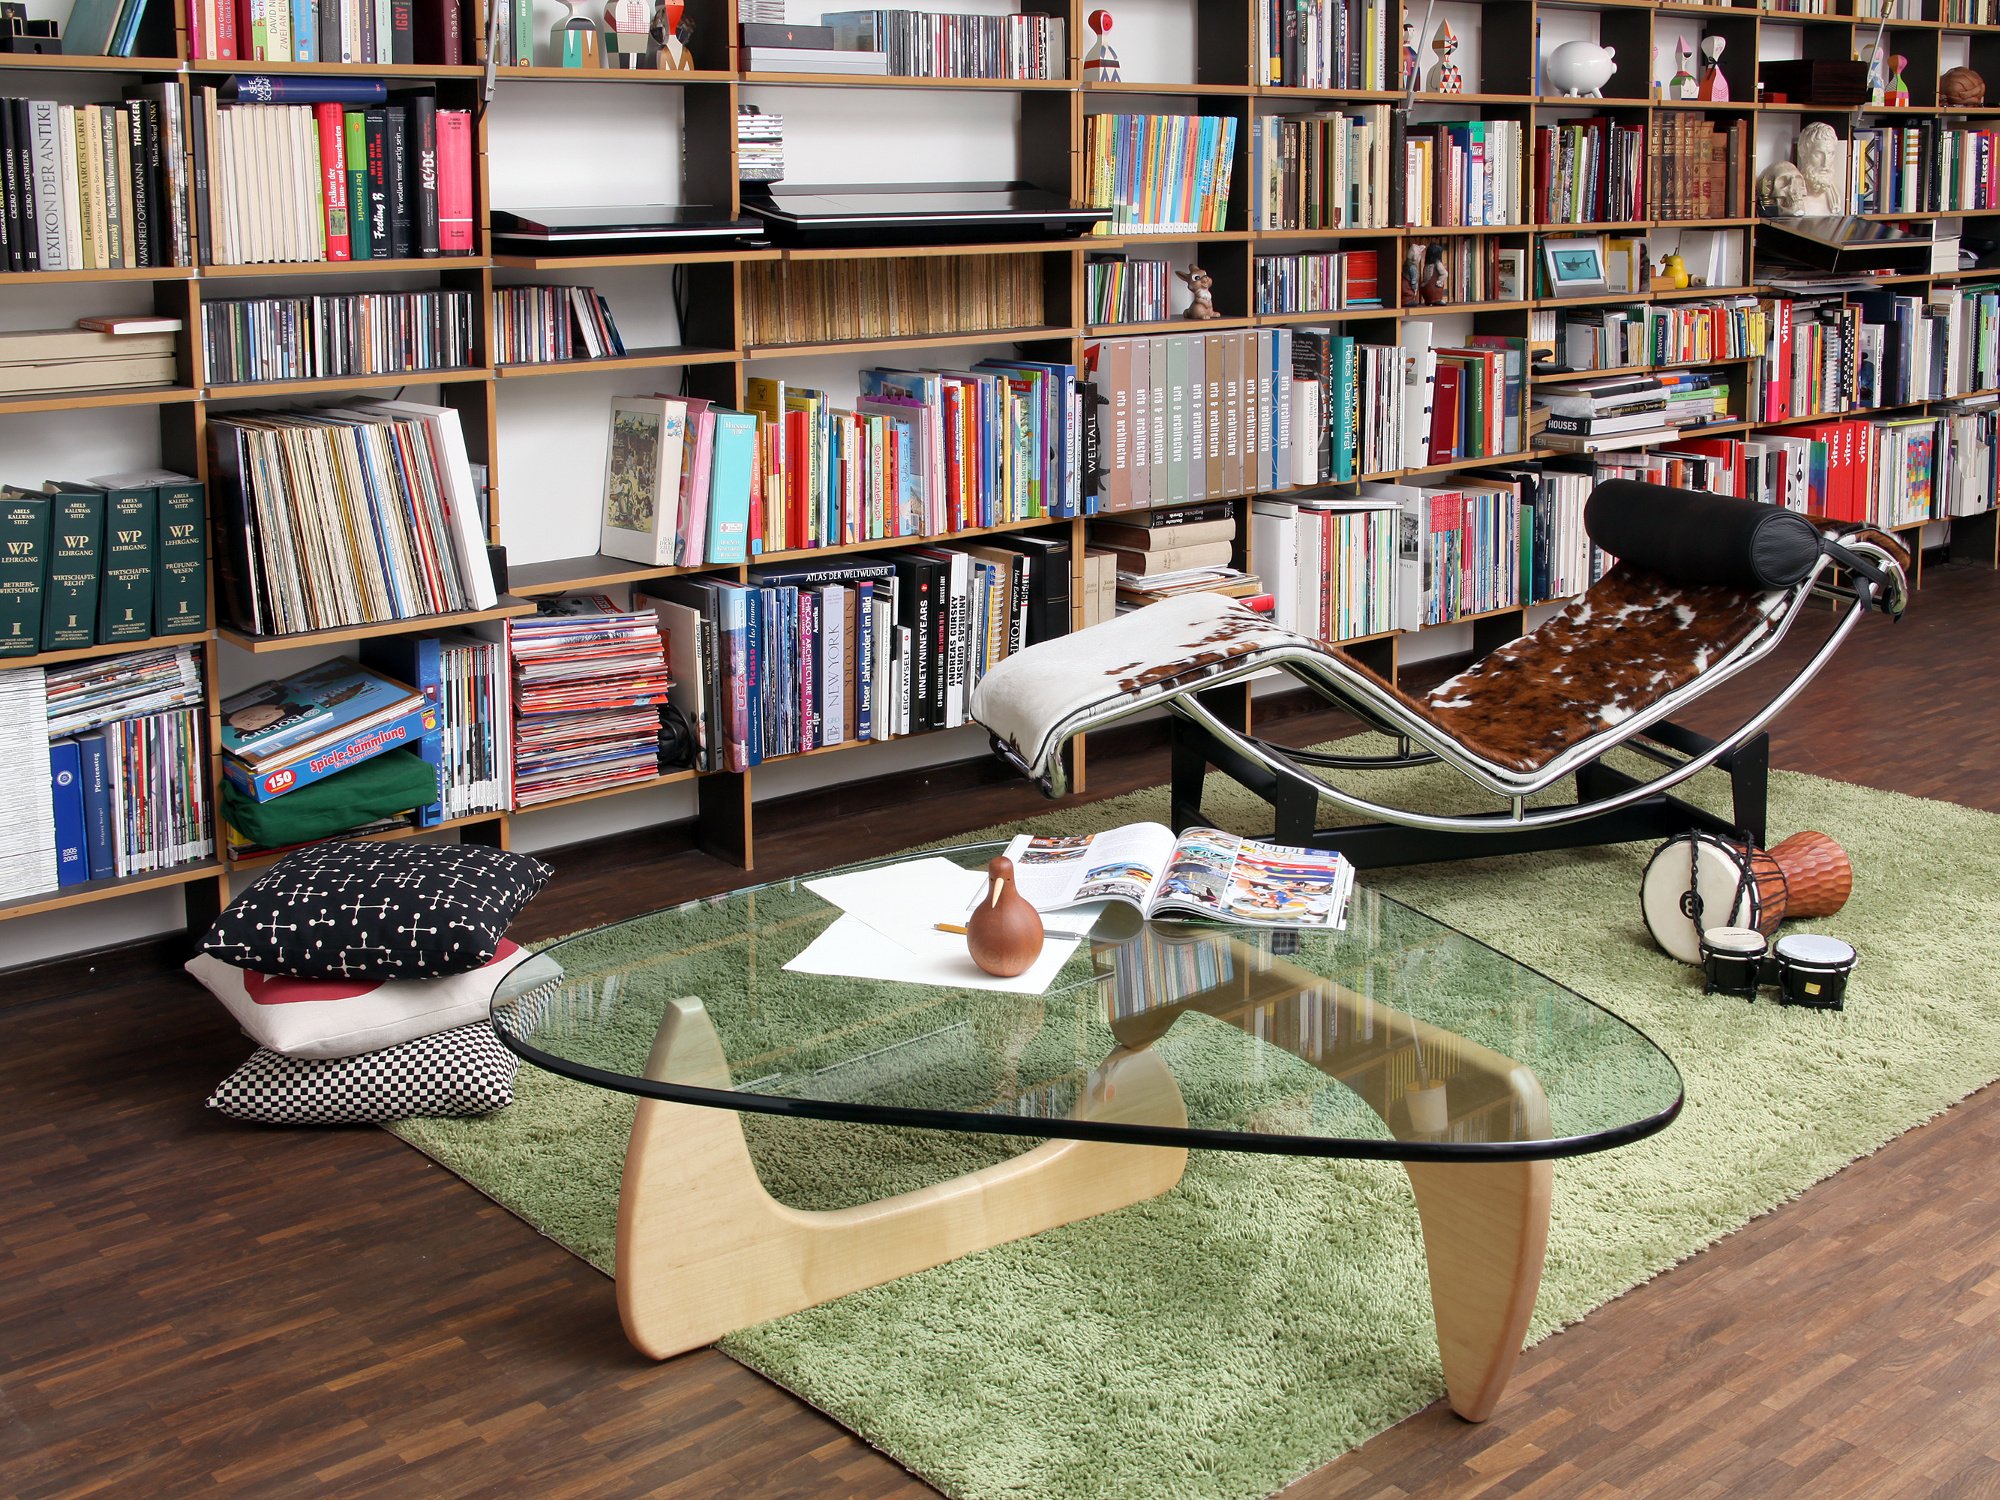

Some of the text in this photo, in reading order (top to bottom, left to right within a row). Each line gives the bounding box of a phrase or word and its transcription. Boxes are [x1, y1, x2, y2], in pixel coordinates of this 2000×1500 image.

[279, 15, 287, 29] AN
[395, 6, 408, 31] IGGY
[279, 29, 288, 50] ZWEI
[248, 79, 258, 95] SEE
[103, 115, 112, 129] Spur
[103, 138, 114, 151] auf
[394, 132, 402, 146] sein
[395, 147, 403, 162] artig
[22, 149, 32, 192] STAATSREDEN
[104, 148, 116, 188] Weltwundern
[335, 125, 346, 207] Baum- und Straucharten
[375, 133, 384, 185] EINEN DRINK
[1981, 154, 1989, 183] Excel
[6, 148, 18, 220] CICERO STAATSREDEN
[36, 104, 62, 267] LEXIKON DER ANTIKE
[77, 115, 93, 241] Lebenslänglich MARCUS CLARKE
[132, 101, 148, 265] MANFRED OPPERMANN THRAKER
[327, 167, 337, 208] Lexikon der
[107, 188, 117, 207] Sieben
[108, 207, 117, 219] Den
[355, 172, 365, 221] Der Forstwirt
[397, 203, 405, 215] Wir
[373, 202, 386, 240] Feeling
[1290, 219, 1295, 228] 2
[1780, 304, 1790, 344] vitra.
[1656, 326, 1664, 359] KOMPASS
[1117, 390, 1126, 407] arts
[1137, 389, 1146, 405] arts
[1154, 387, 1163, 404] arts
[1173, 385, 1182, 402] arts
[1193, 384, 1202, 400] arts
[1210, 382, 1219, 398] arts
[1227, 381, 1236, 397] arts
[1247, 379, 1255, 395] arts
[1261, 378, 1270, 394] arts
[1281, 376, 1289, 391] arts
[1343, 344, 1353, 451] Relics Damien Hirst
[1154, 416, 1164, 465] architecture
[1173, 414, 1183, 462] architecture
[1193, 412, 1203, 460] architecture
[1210, 410, 1220, 458] architecture
[1227, 409, 1237, 457] architecture
[1247, 406, 1256, 454] architecture
[1261, 405, 1271, 452] architecture
[1281, 403, 1290, 450] architecture
[1548, 419, 1578, 431] HOUSES
[1087, 413, 1098, 474] WELTALL
[1117, 419, 1127, 469] architecture
[1137, 417, 1147, 467] architecture
[1831, 430, 1840, 469] vitra.
[1844, 428, 1852, 467] vitra.
[1858, 425, 1867, 464] vitra.
[875, 472, 883, 521] Puzzlebuch
[63, 535, 90, 549] WP
[112, 544, 147, 552] LEHRGANG
[117, 530, 142, 543] WP
[165, 538, 200, 546] LEHRGANG
[169, 525, 194, 538] WP
[7, 542, 34, 555] WP
[108, 567, 151, 576] WIRTSCHAFTS-
[165, 561, 200, 570] PRÜFUNGS-
[806, 567, 889, 582] ATLAS DER WELTWUNDER
[70, 588, 77, 596] 2
[748, 598, 760, 687] Picasso et les femmes
[844, 602, 854, 688] NEW YORK
[861, 596, 872, 712] Unser Jahrhundert im Bild
[918, 599, 928, 699] NINETYNINEYEARS
[949, 596, 959, 687] ANDREAS GURSKY
[956, 595, 966, 686] ANDREAS GURSKY
[803, 596, 814, 751] CHICAGO ARCHITECTURE AND DESIGN
[828, 623, 840, 708] NEW YORK
[737, 673, 747, 709] USA
[241, 714, 305, 743] Rotary
[309, 726, 406, 773] Spiele-Sammlung
[268, 770, 292, 789] 150
[62, 847, 78, 855] 2005
[63, 855, 78, 863] 2006
